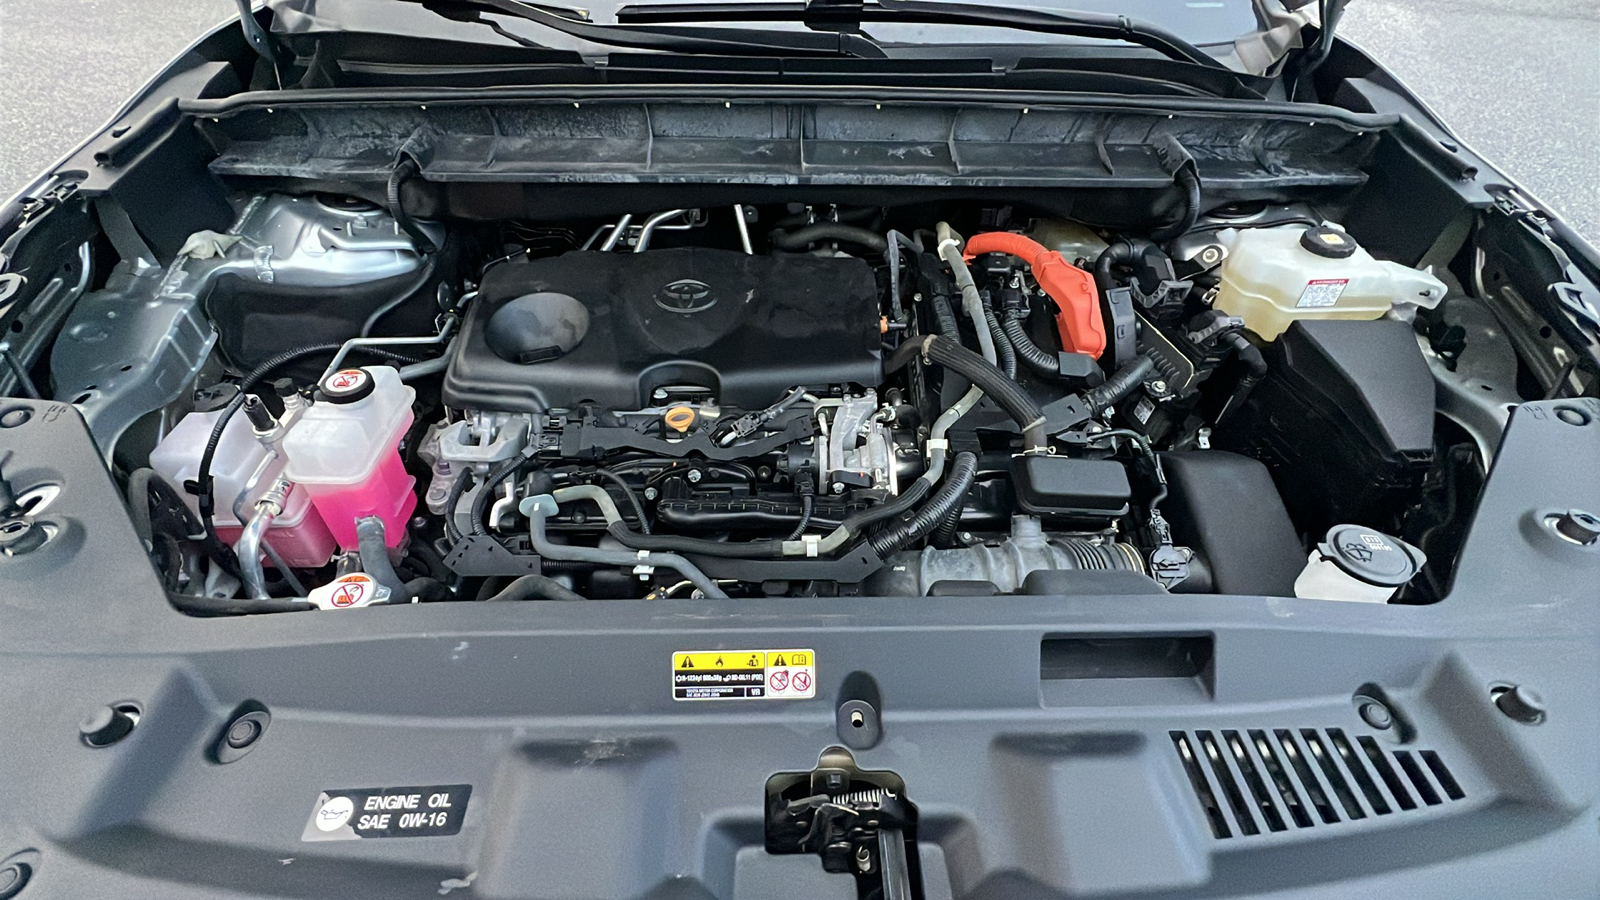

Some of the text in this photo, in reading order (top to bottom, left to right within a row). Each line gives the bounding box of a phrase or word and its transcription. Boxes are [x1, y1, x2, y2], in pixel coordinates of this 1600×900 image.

[364, 793, 452, 811] ENGINE OIL
[357, 812, 447, 830] SAE 0W-16
